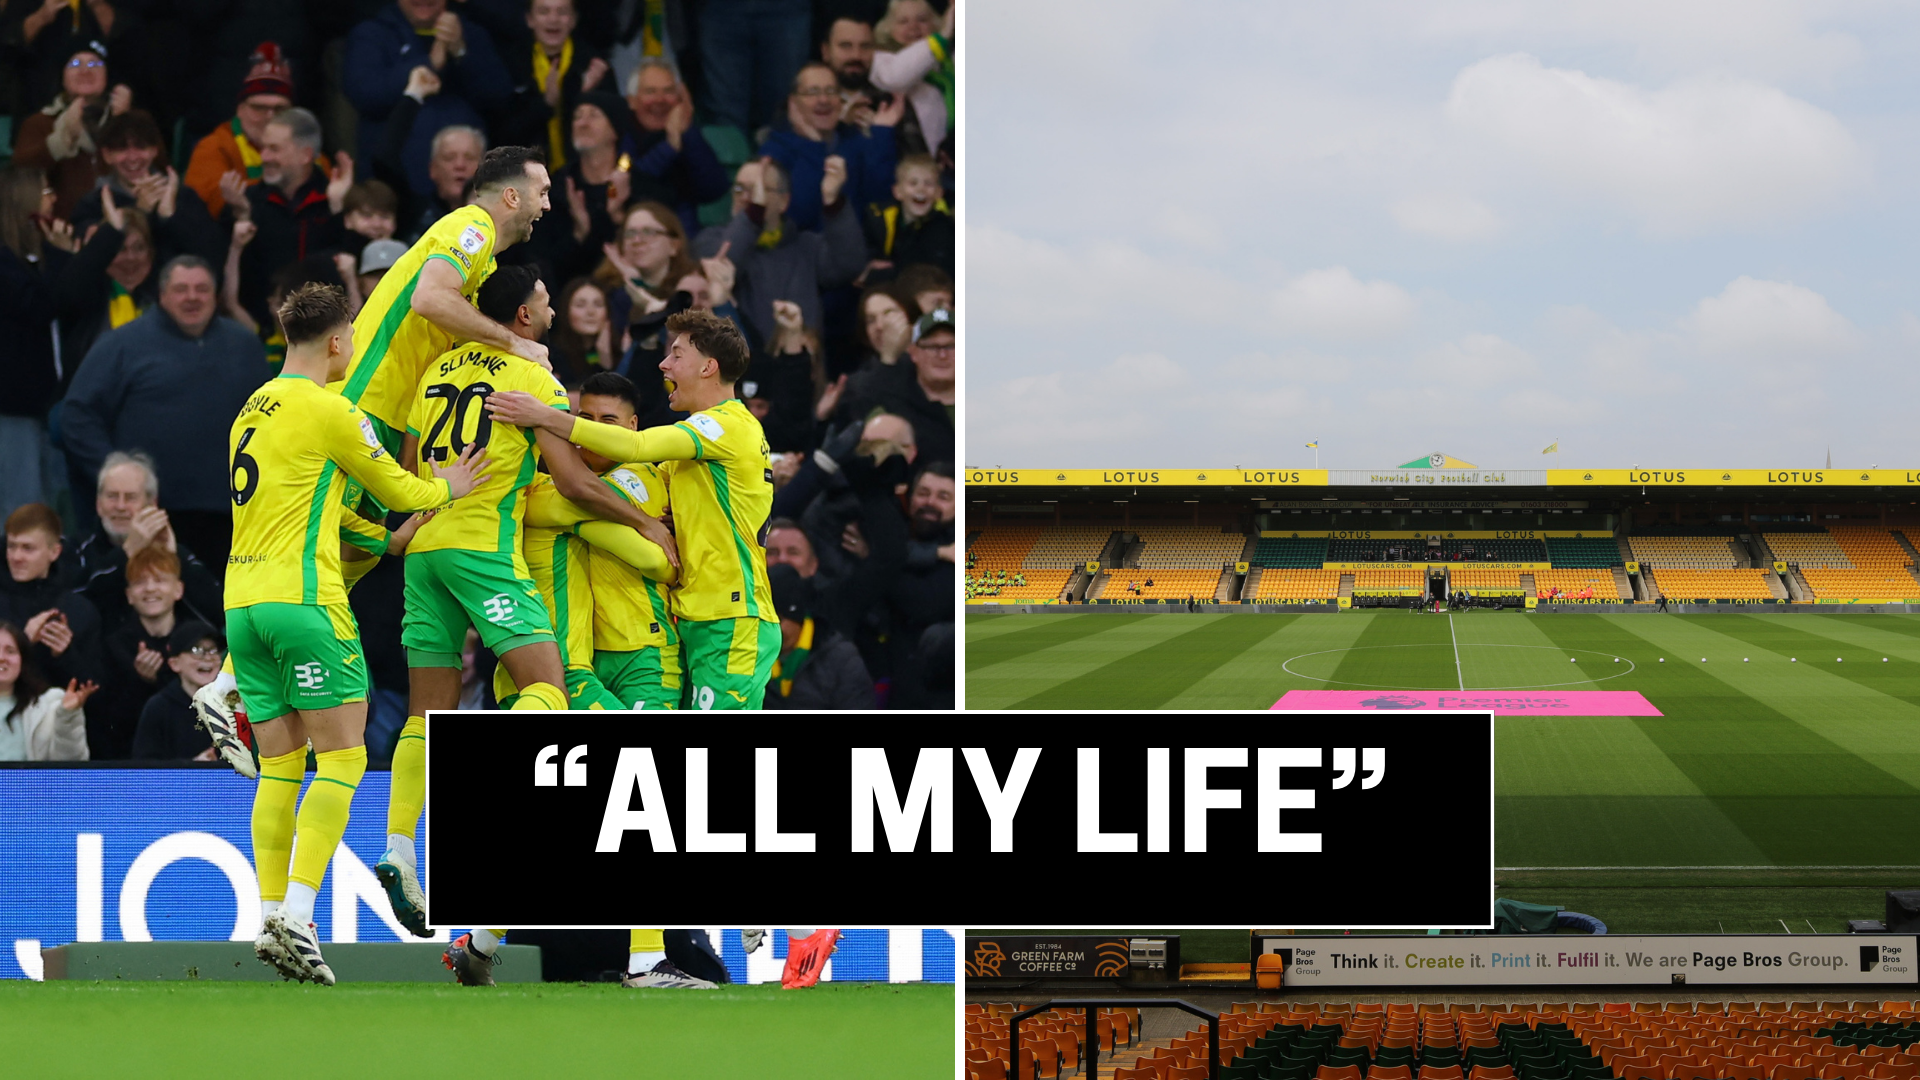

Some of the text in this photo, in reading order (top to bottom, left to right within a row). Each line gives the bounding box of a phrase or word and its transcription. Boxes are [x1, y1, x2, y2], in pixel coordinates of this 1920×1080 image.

[440, 351, 507, 377] SLIMANE
[422, 382, 495, 462] 20
[232, 427, 259, 506] 6
[965, 472, 1019, 483] LOTUS
[1104, 471, 1160, 483] LOTUS
[1244, 471, 1300, 483] LOTUS
[1370, 472, 1506, 484] Norwich City Football Club
[1630, 471, 1685, 483] LOTUS
[1768, 471, 1823, 483] LOTUS
[1332, 531, 1371, 539] LOTUS
[1496, 531, 1535, 539] LOTUS
[1295, 947, 1316, 957] Page
[1882, 946, 1902, 954] Page
[1011, 951, 1085, 962] GREEN FARM
[1295, 958, 1314, 966] Bros
[1330, 951, 1848, 971] Think it. Create it. Print it. Fulfil it. We are Page Bros Group.
[1882, 955, 1901, 963] Bros
[1019, 961, 1063, 972] COFFEE
[1295, 967, 1321, 977] Group
[1882, 964, 1908, 973] Group
